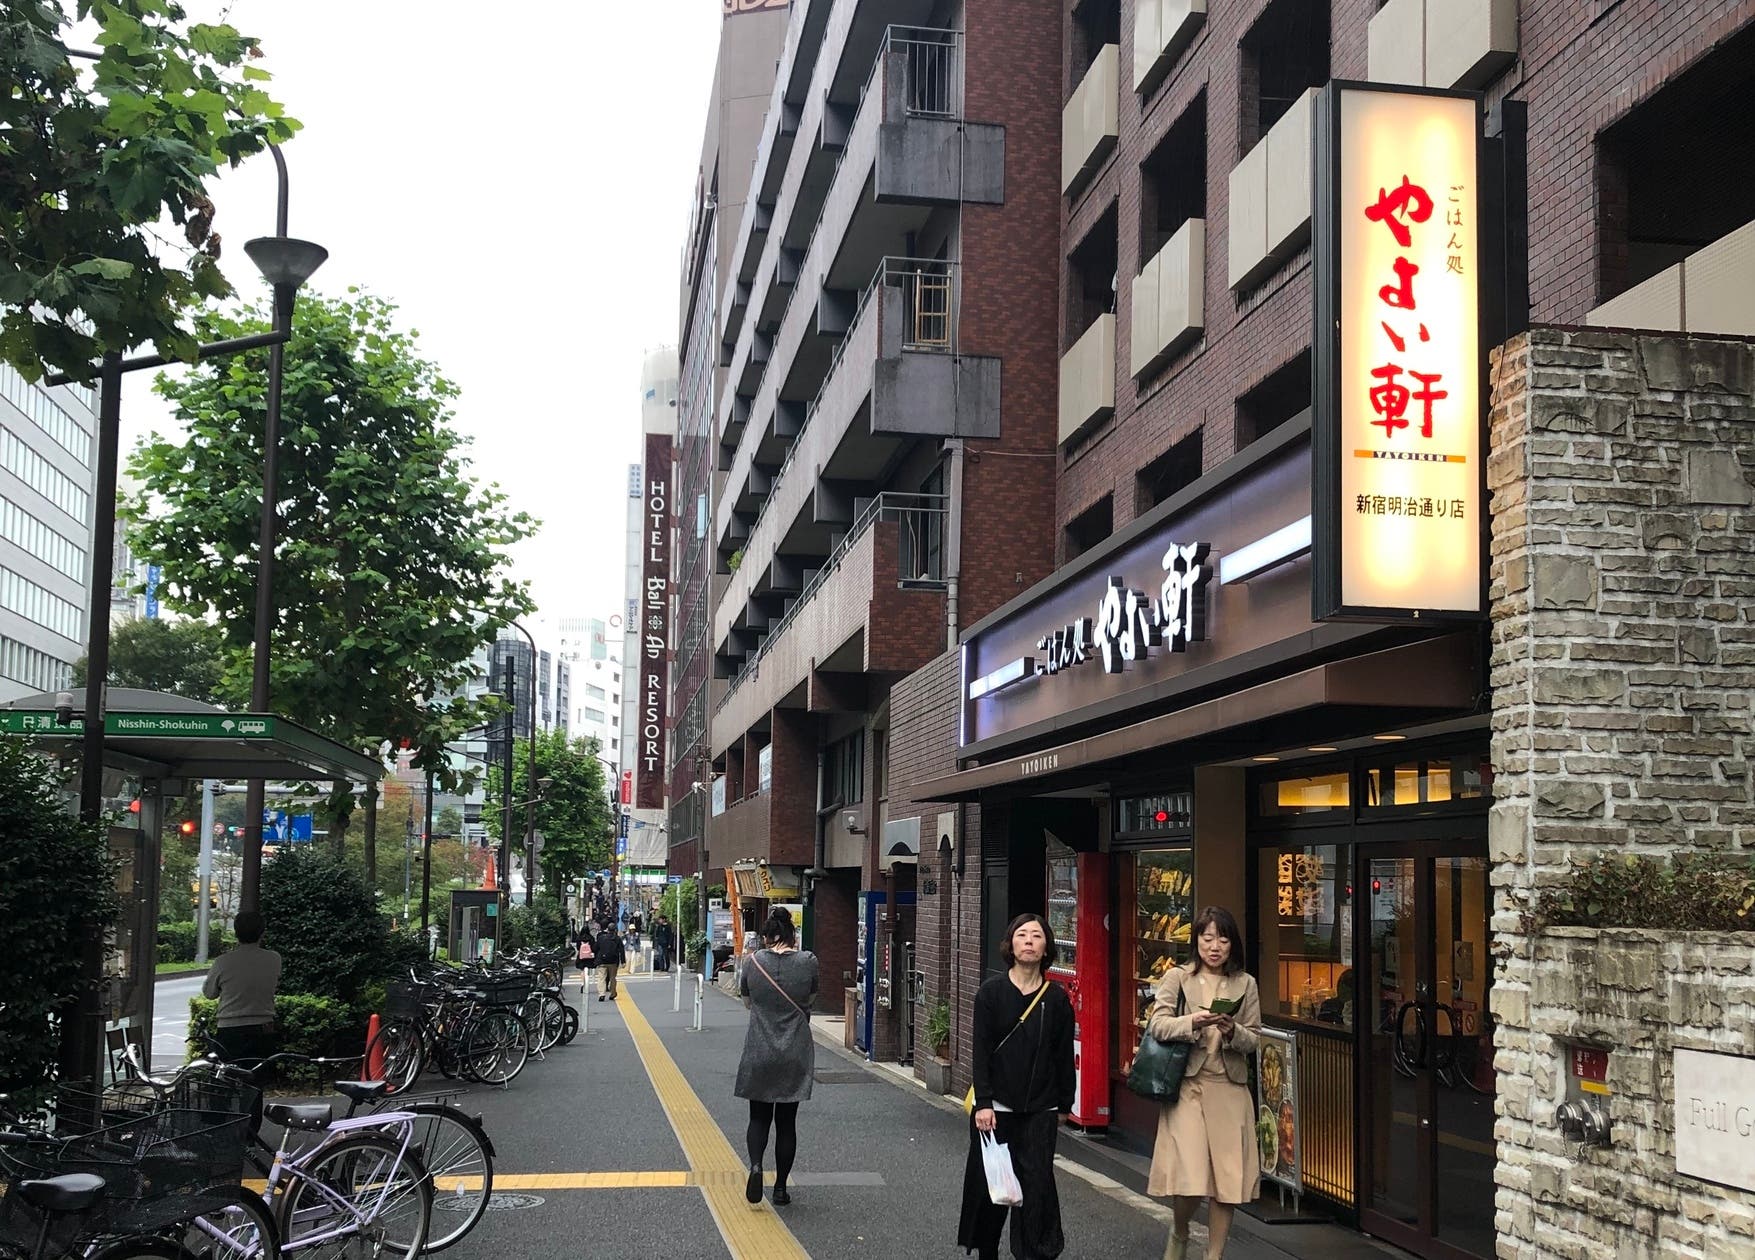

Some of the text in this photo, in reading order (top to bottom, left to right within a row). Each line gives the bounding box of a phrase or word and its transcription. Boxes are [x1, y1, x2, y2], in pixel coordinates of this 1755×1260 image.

[1446, 185, 1465, 275] ごはん処
[1365, 174, 1448, 438] やよい軒
[1376, 451, 1444, 462] YAYOIKEN
[650, 481, 665, 562] HOTEL
[1356, 494, 1465, 519] 新宿明治通り店
[647, 576, 666, 610] Bali
[1036, 541, 1203, 675] ごはん処 やよい軒
[117, 719, 208, 731] Nisshin-Shokuhin
[644, 675, 661, 772] RESORT
[1020, 754, 1059, 775] YAYOIKEN
[1689, 1097, 1755, 1137] Full G
